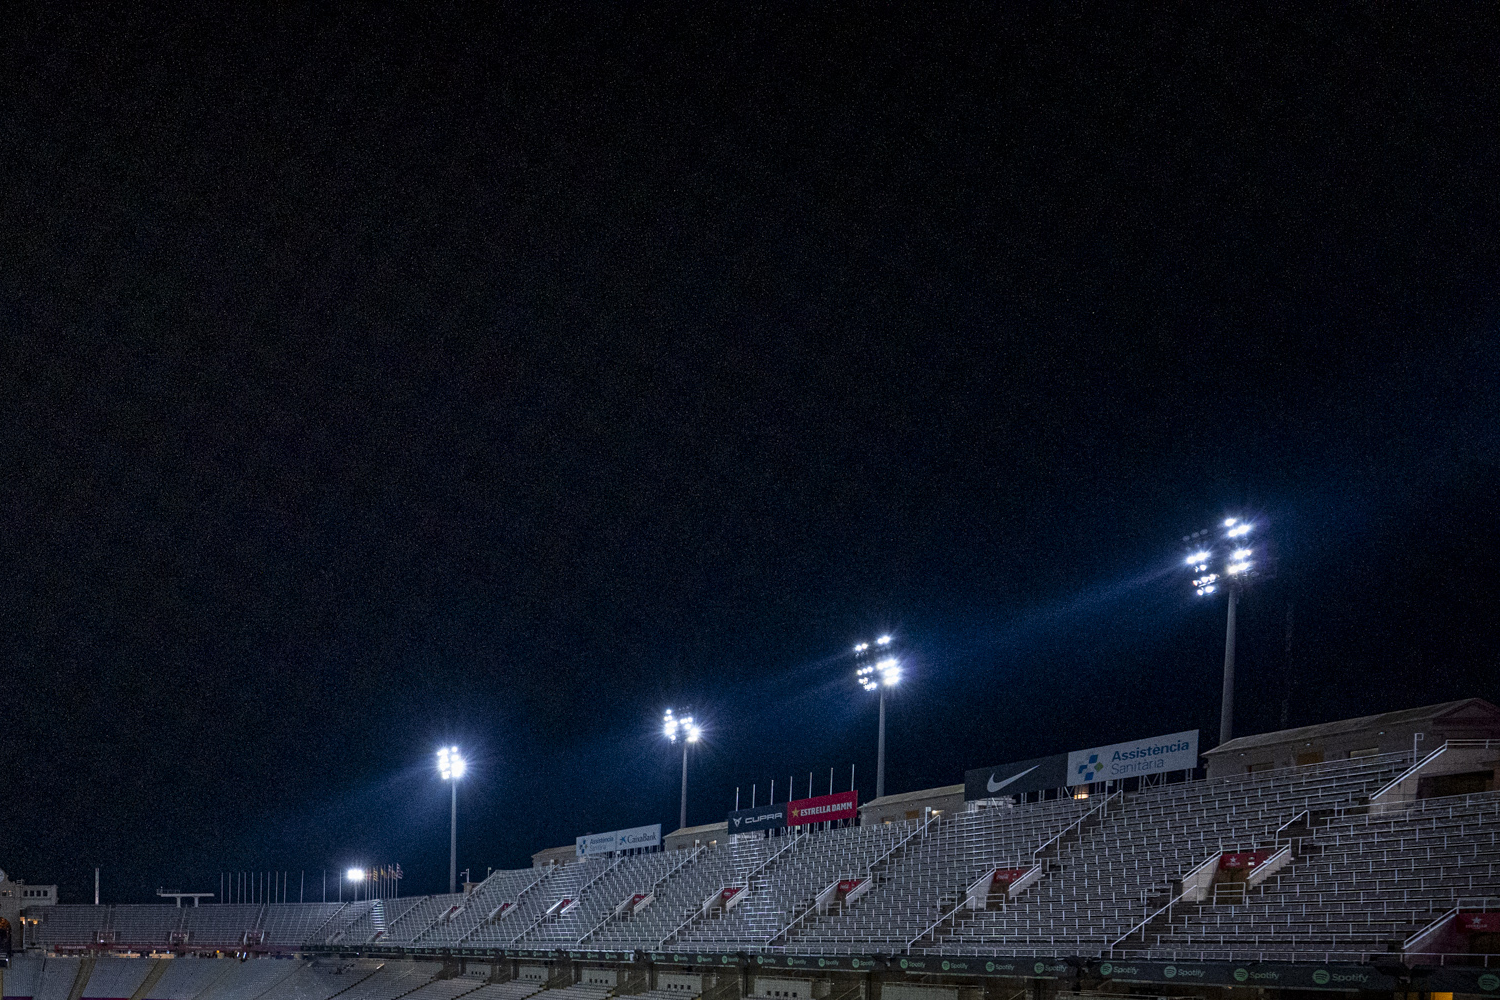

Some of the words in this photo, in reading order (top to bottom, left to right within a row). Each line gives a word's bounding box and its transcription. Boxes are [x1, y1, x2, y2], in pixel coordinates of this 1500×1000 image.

[1112, 740, 1189, 762] Assistència
[800, 804, 831, 816] ESTRELLA
[831, 801, 852, 812] DAMM
[744, 813, 782, 824] CUPRA
[627, 832, 657, 844] CaixaBank
[1113, 966, 1139, 975] Spotify
[1178, 969, 1206, 978] Spotify
[1250, 972, 1280, 980] Spotify
[1331, 973, 1369, 983] Spotify
